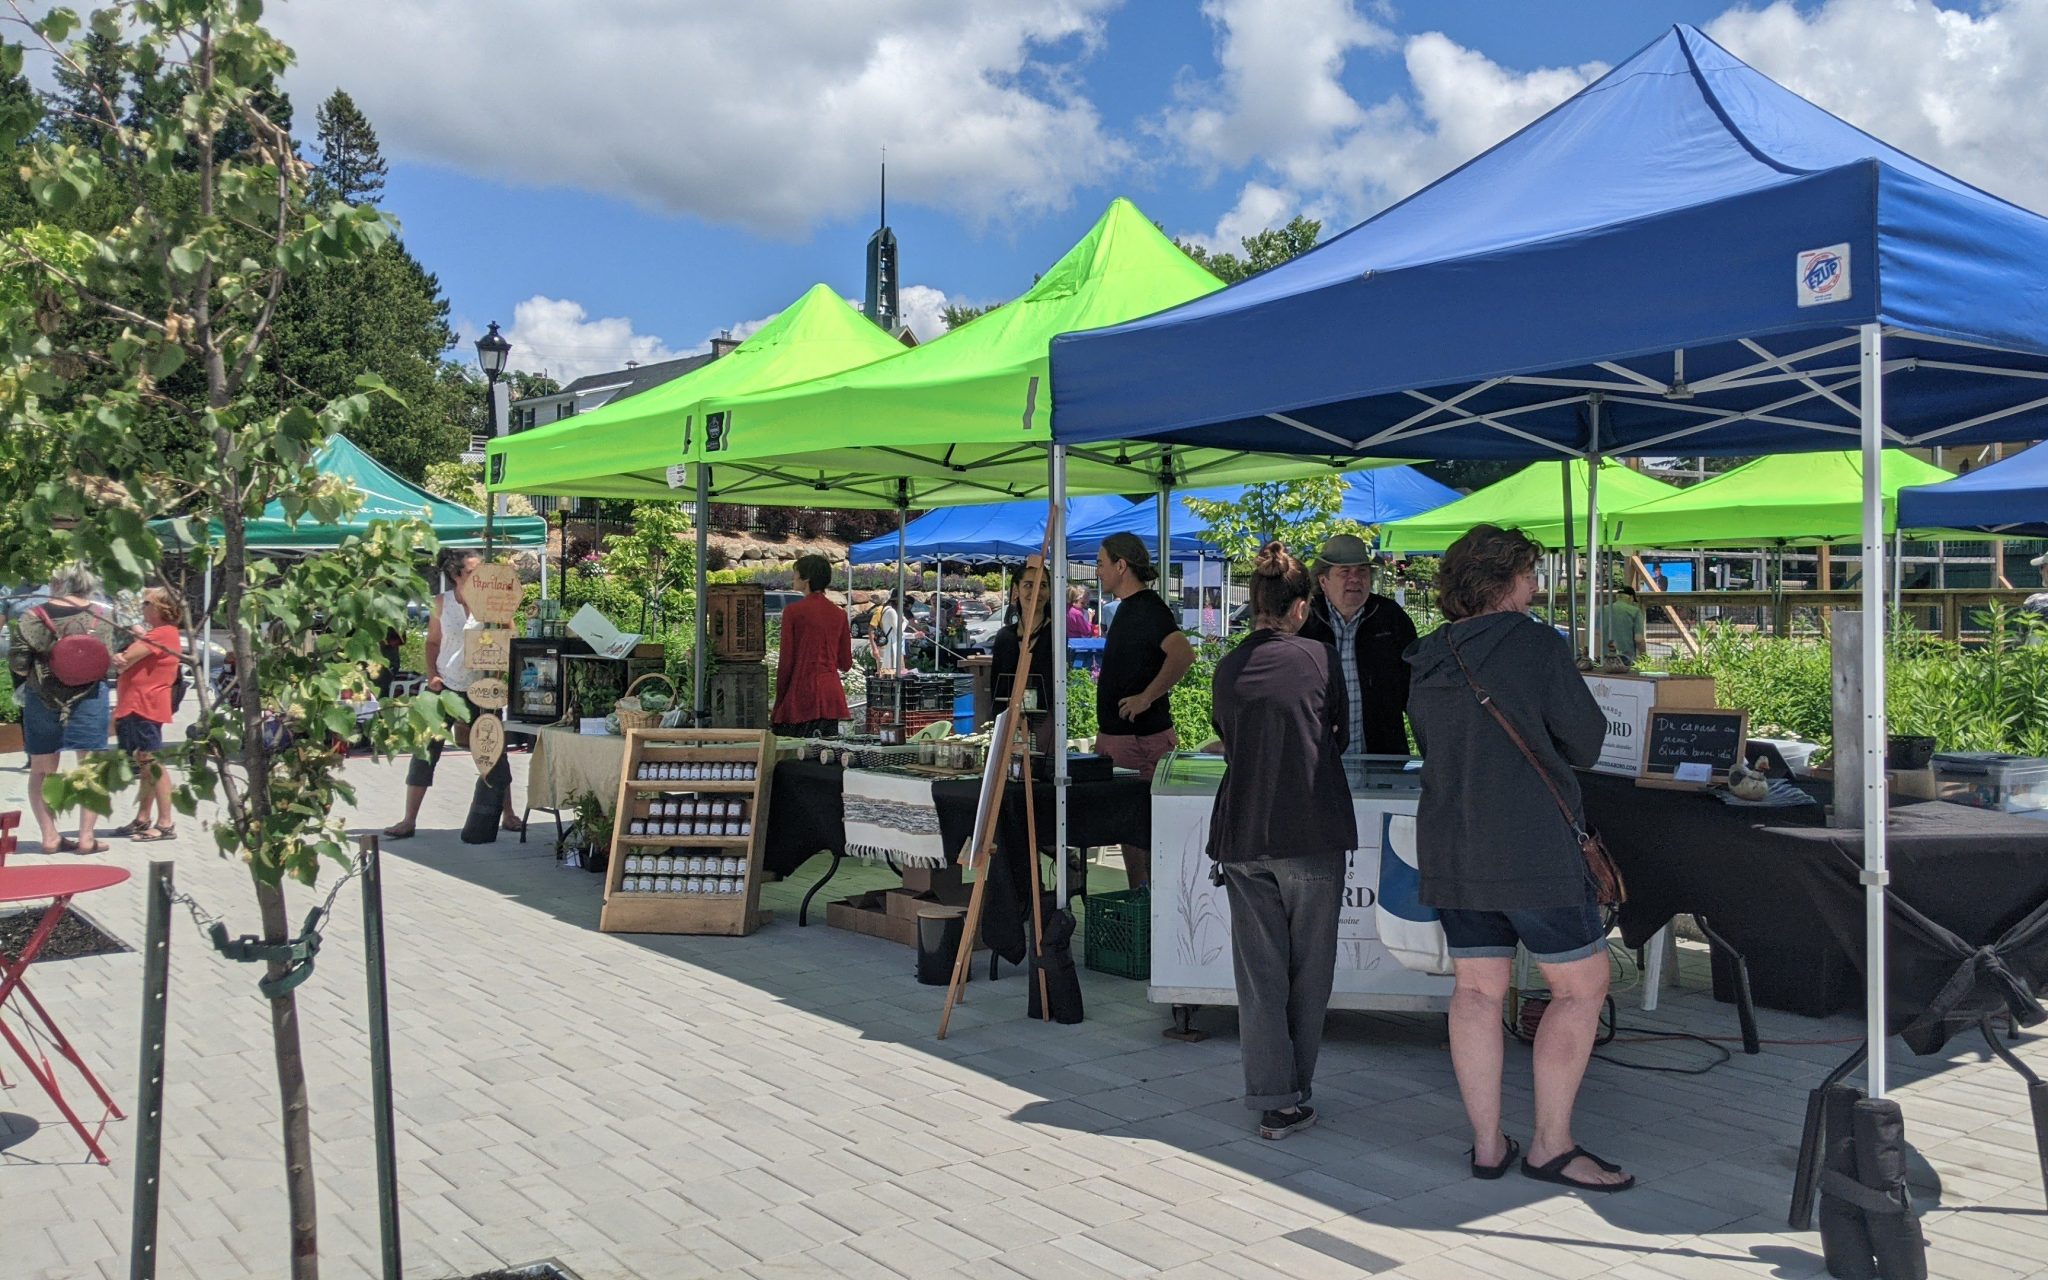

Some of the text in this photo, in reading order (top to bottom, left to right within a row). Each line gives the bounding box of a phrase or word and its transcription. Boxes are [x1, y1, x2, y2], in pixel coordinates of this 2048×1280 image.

[472, 575, 514, 591] Papriland
[1657, 717, 1676, 731] Du
[1680, 722, 1717, 733] canard
